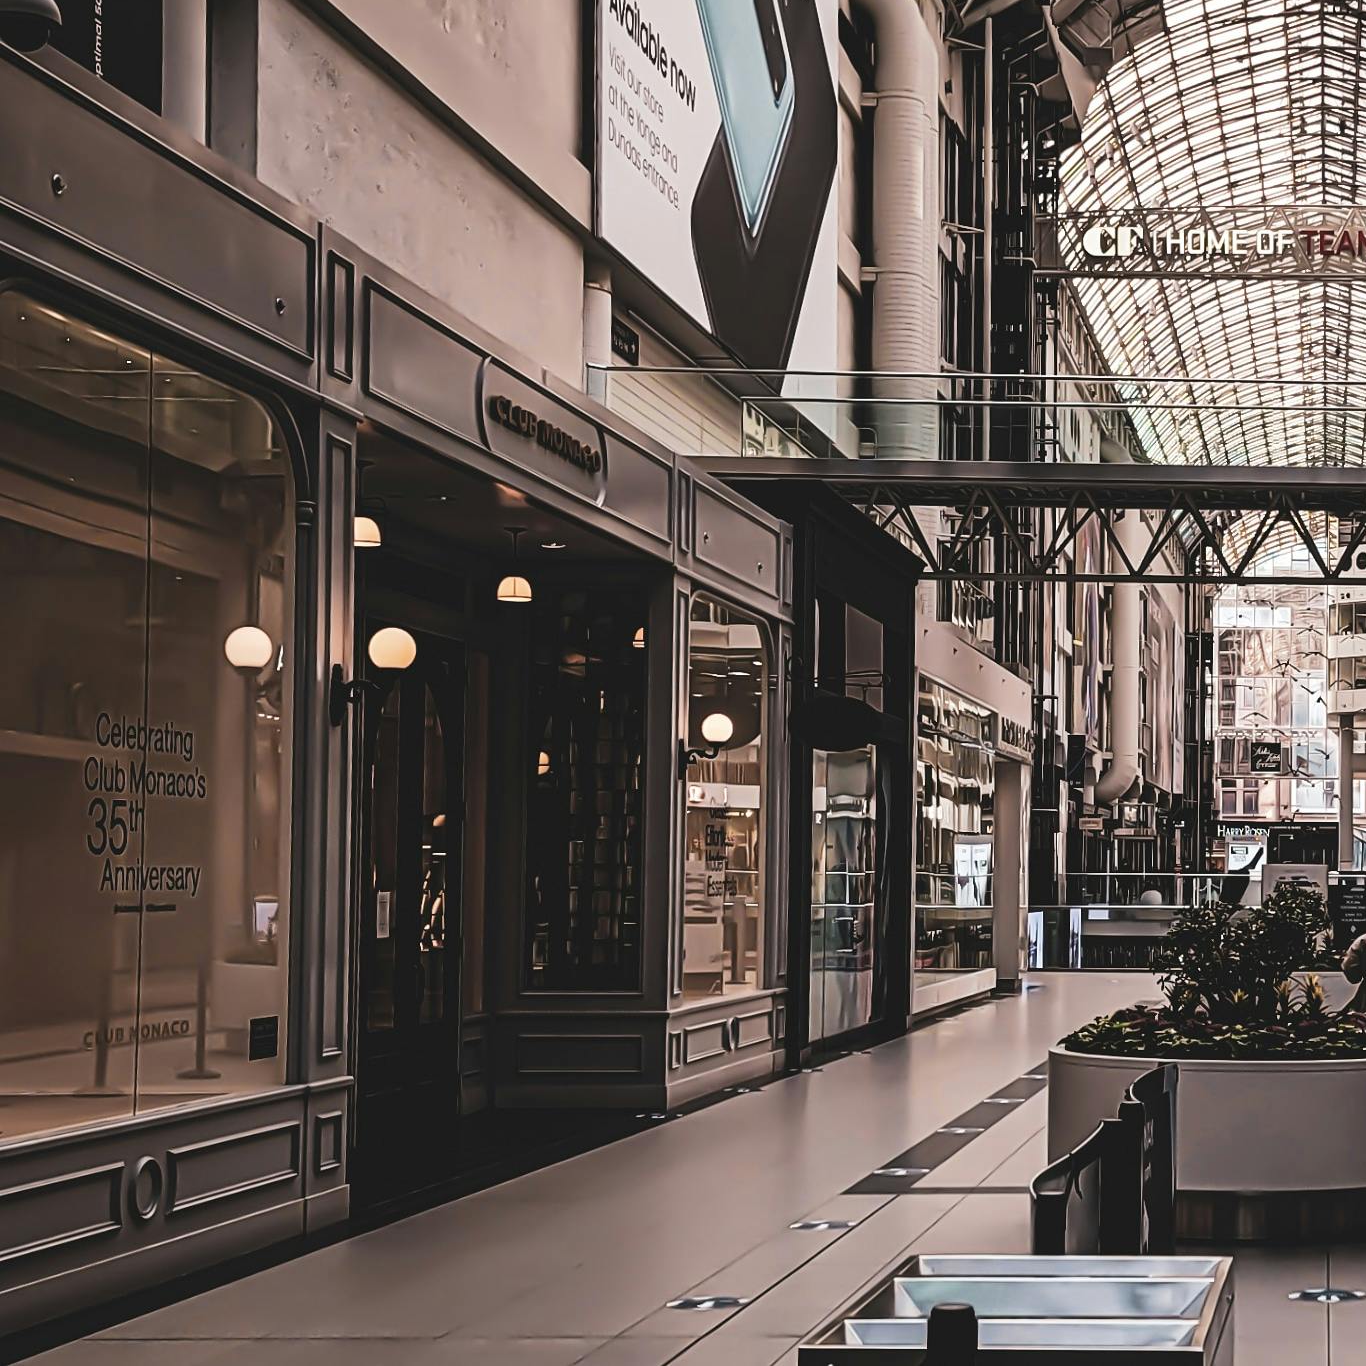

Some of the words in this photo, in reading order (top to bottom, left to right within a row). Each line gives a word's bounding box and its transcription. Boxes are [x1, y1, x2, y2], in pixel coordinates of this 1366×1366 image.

[94, 18, 103, 77] ptimal
[609, 41, 626, 81] Visit
[627, 68, 642, 98] our
[643, 83, 664, 123] store
[671, 57, 696, 112] now
[609, 84, 618, 106] at
[620, 97, 634, 126] the
[636, 112, 661, 156] Yonge
[662, 143, 678, 174] and
[609, 117, 641, 171] Dundas
[643, 158, 680, 211] entrance.
[1166, 229, 1249, 255] HOME
[1256, 229, 1294, 255] OF
[96, 713, 194, 762] Celebrating
[84, 756, 126, 793] Club
[129, 761, 206, 798] Monaco's
[86, 797, 145, 856] 35th
[101, 857, 200, 898] Anniversary
